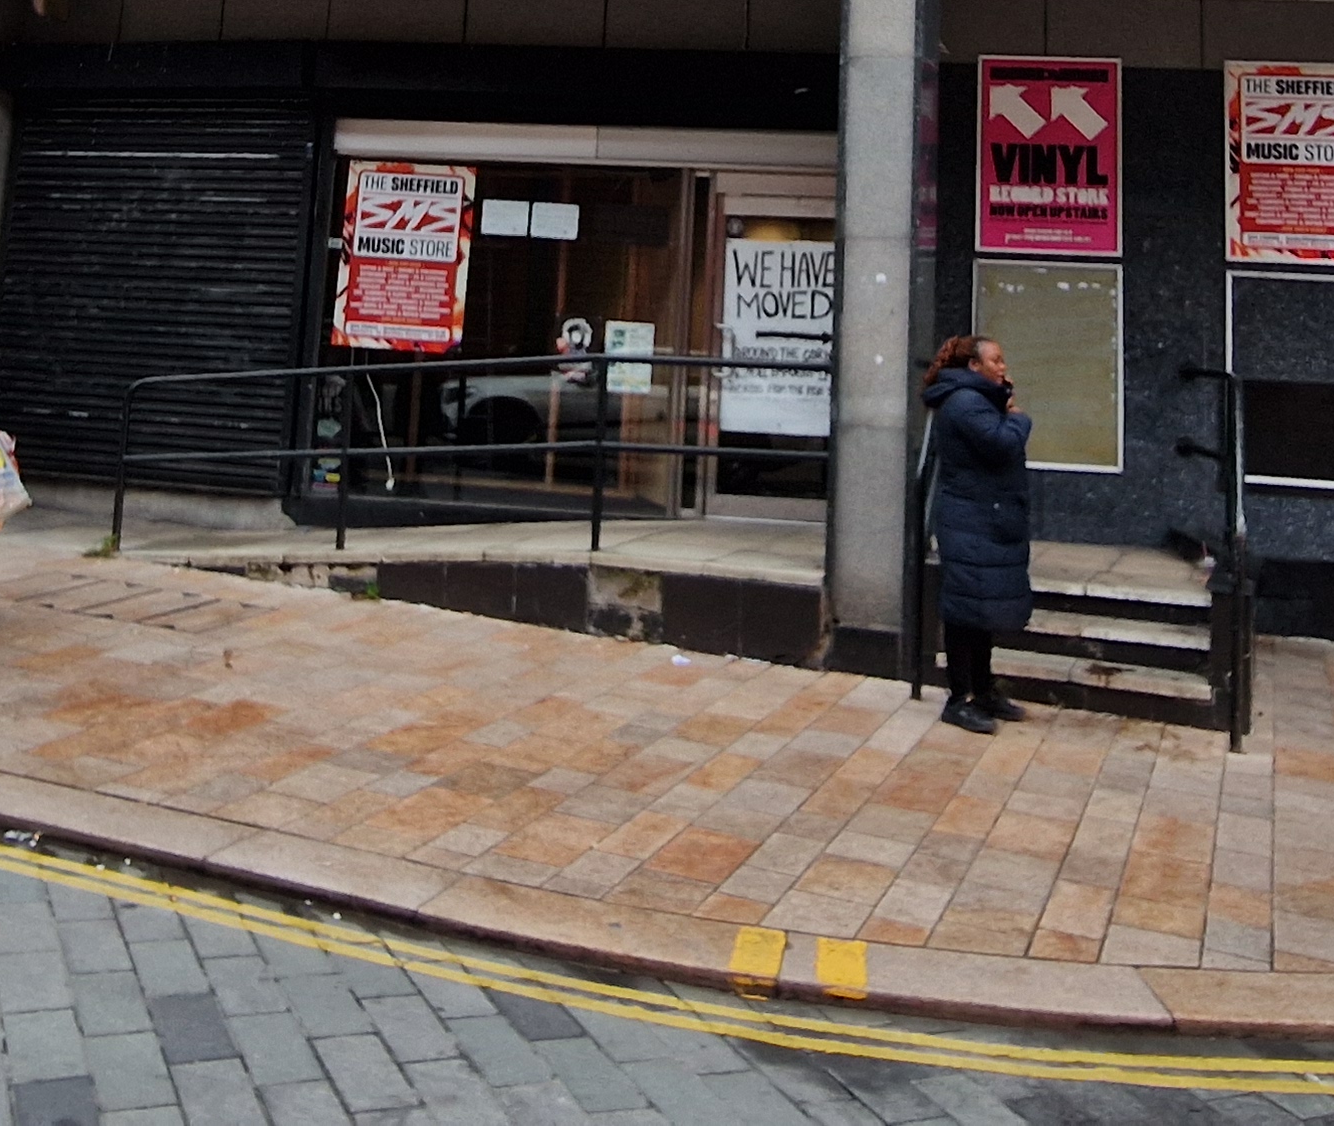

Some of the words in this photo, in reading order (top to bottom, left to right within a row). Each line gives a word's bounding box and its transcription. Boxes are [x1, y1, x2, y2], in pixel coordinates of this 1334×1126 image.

[1245, 78, 1272, 94] THE
[1246, 142, 1299, 161] MUSIC
[990, 142, 1109, 186] VINYL
[364, 175, 387, 190] THE
[391, 176, 459, 194] SHEFFIELD
[1017, 205, 1048, 218] OPEN
[357, 235, 405, 255] MUSIC
[409, 239, 454, 258] STORE
[733, 249, 774, 288] WE
[780, 250, 835, 288] HAVE
[737, 290, 834, 319] MOVED
